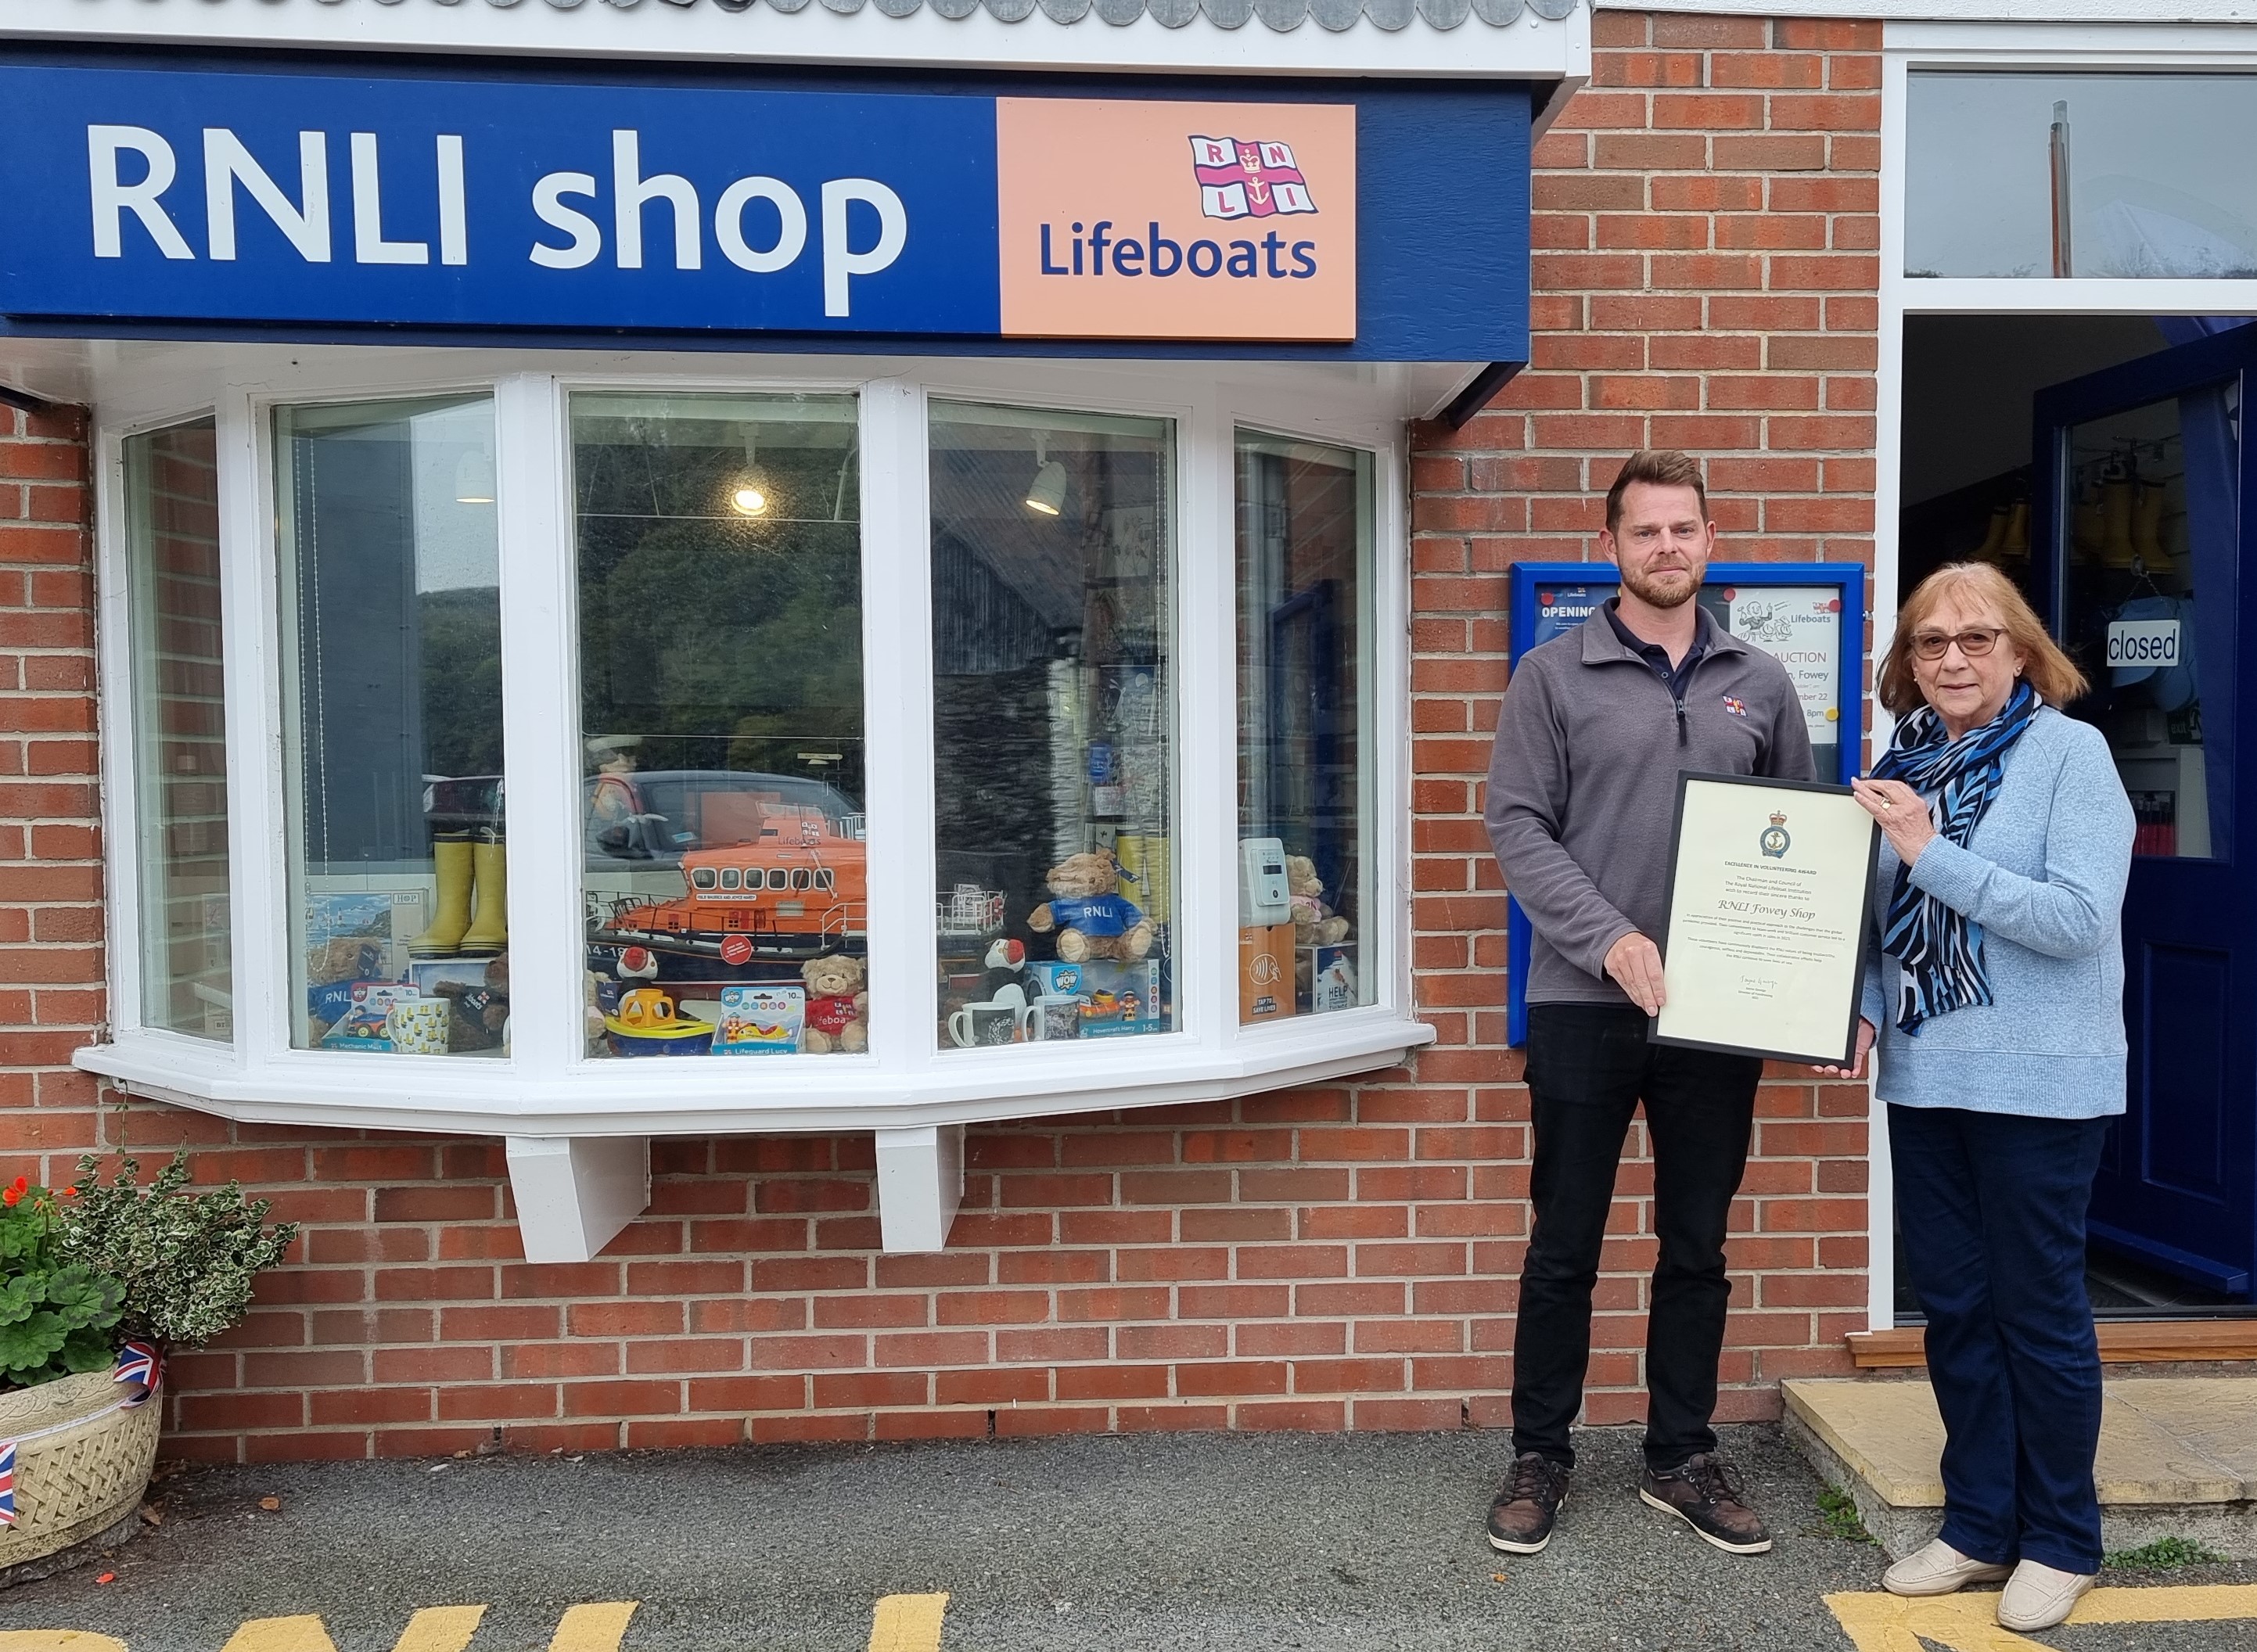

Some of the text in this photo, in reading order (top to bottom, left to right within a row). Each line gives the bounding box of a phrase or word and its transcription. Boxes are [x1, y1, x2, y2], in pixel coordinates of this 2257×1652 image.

[1206, 143, 1286, 163] R N
[1217, 187, 1296, 213] L I
[87, 124, 907, 317] RNLI shop
[1040, 221, 1317, 279] Lifeboats
[1791, 615, 1831, 623] Lifeboats
[2108, 628, 2176, 660] closed
[1799, 670, 1829, 681] Fowey
[1806, 709, 1824, 718] 8pm
[1084, 906, 1113, 918] RNLI
[1718, 900, 1816, 921] RNLI Fowey Shop
[1056, 975, 1077, 988] WOW
[325, 990, 352, 1004] RNL
[1329, 986, 1348, 997] HELP
